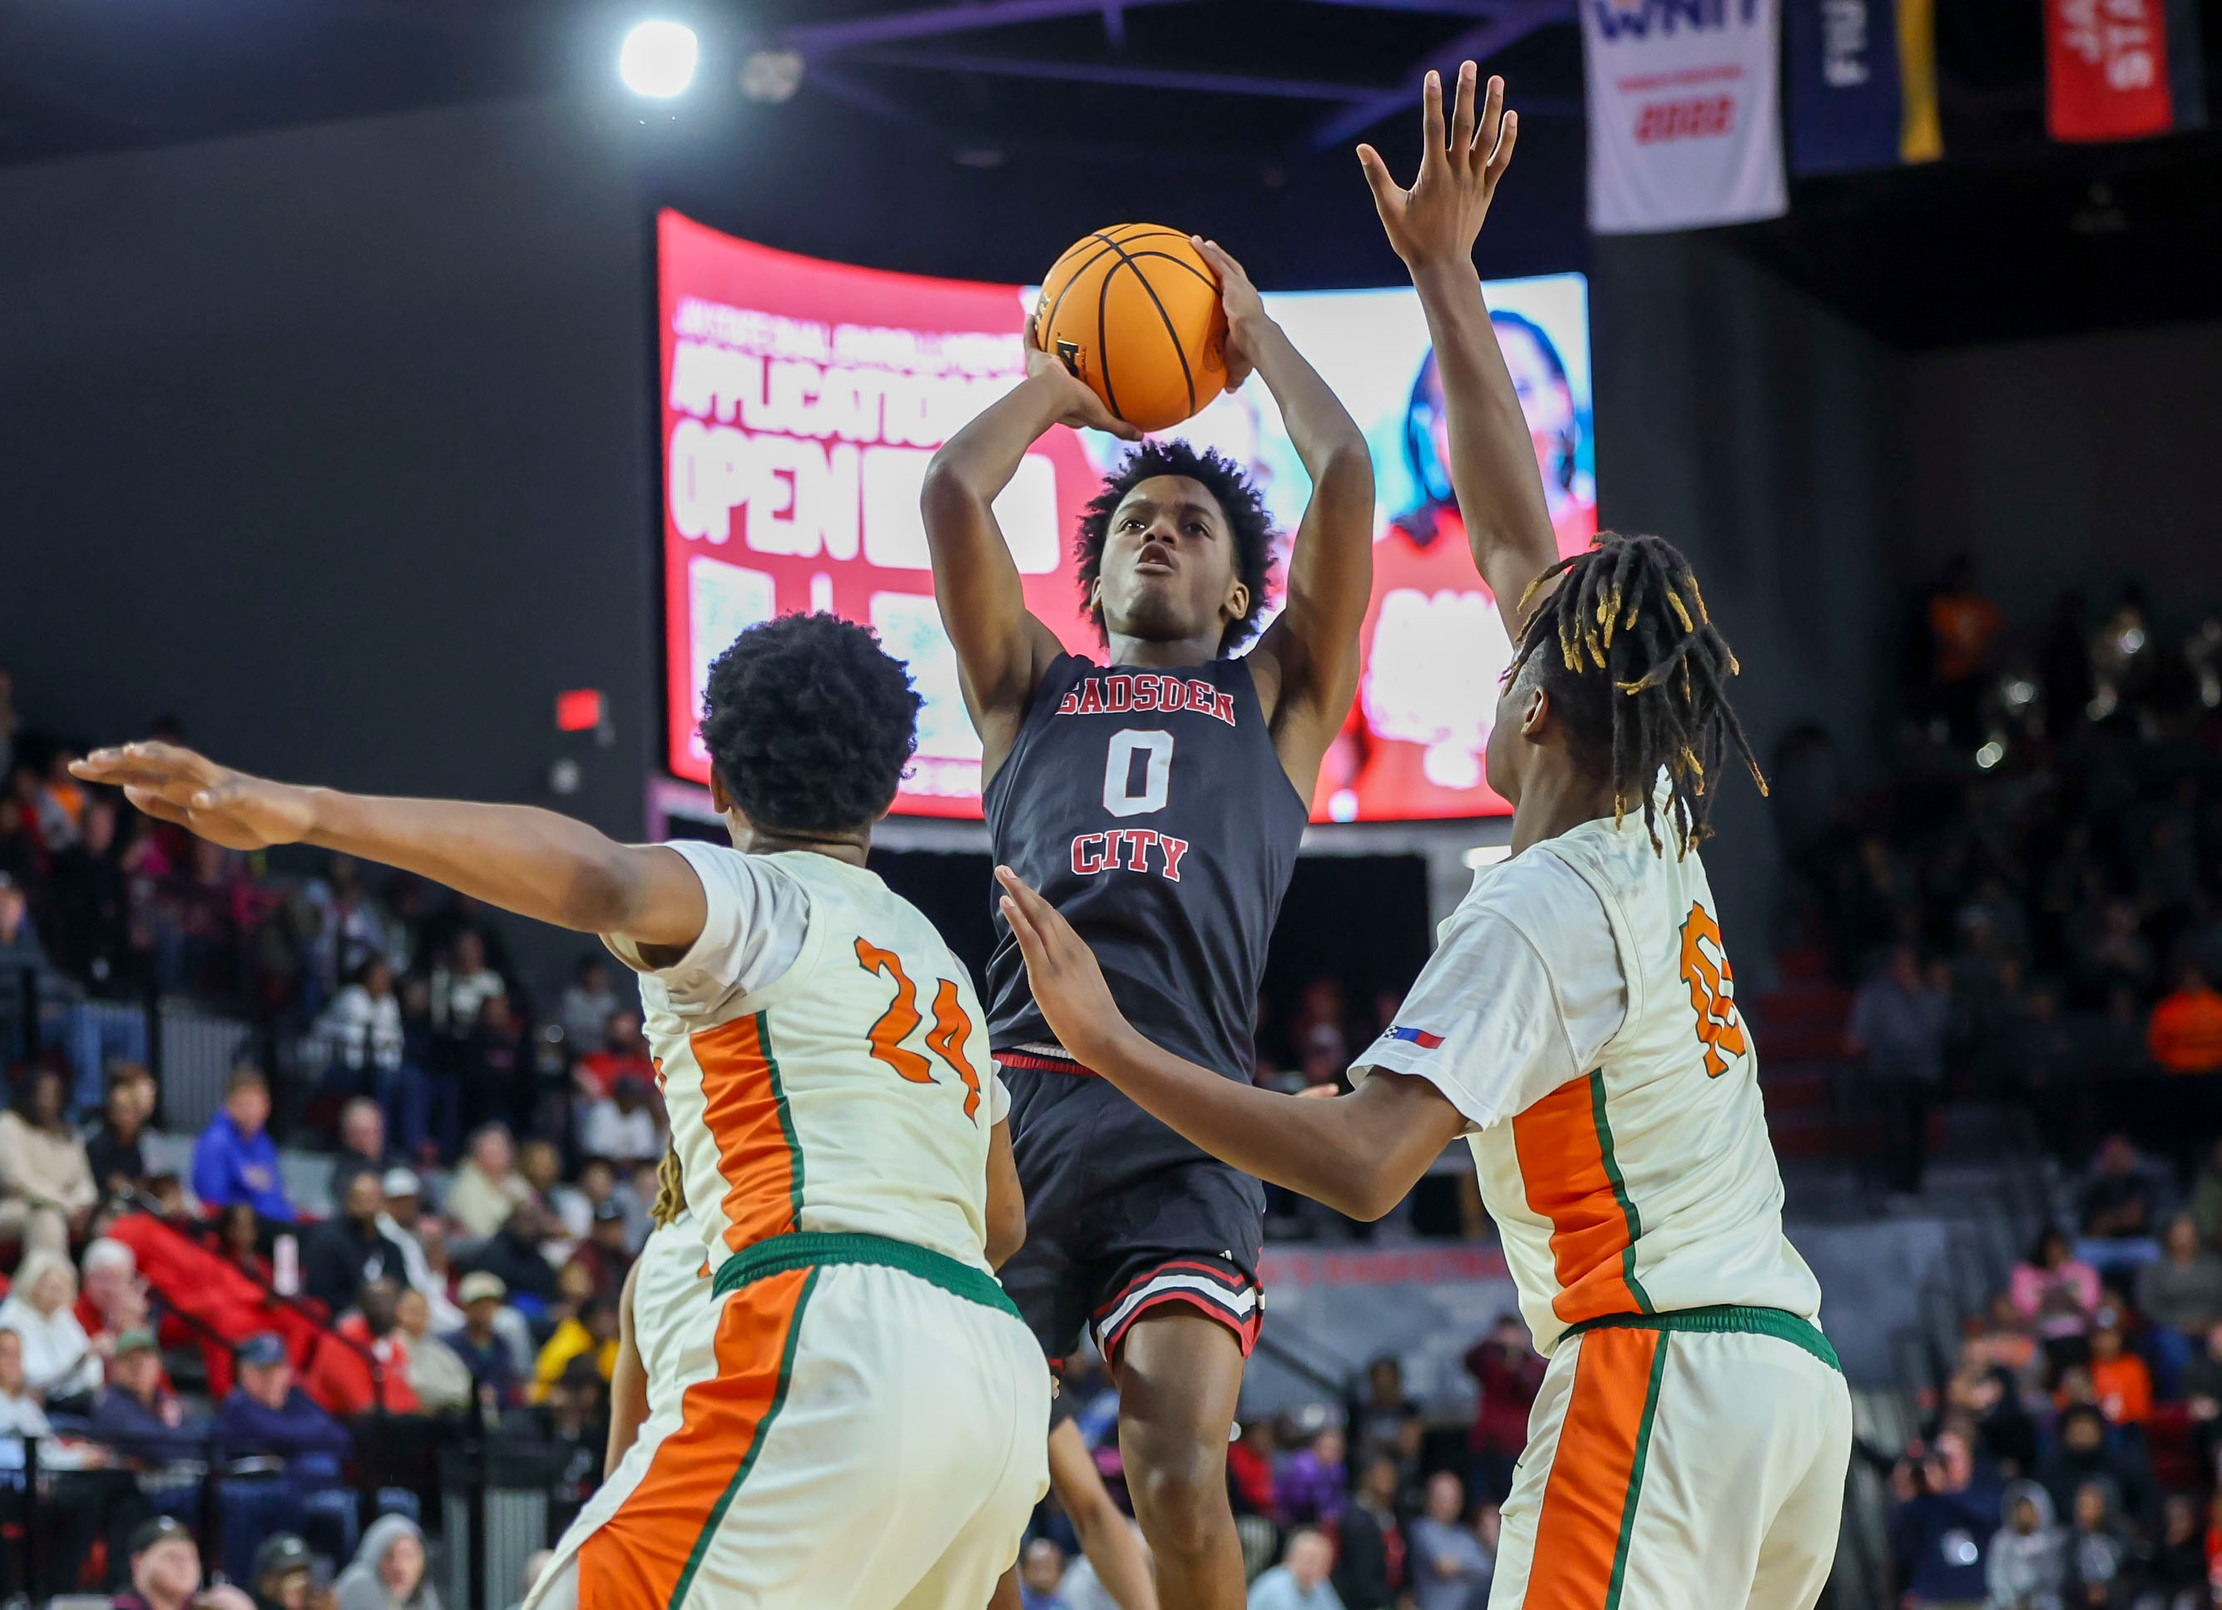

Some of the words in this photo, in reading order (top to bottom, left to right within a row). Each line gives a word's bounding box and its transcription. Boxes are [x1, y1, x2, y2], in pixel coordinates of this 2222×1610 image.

[1103, 727, 1175, 818] 0
[1070, 829, 1189, 883] CITY
[853, 936, 982, 1130] 24
